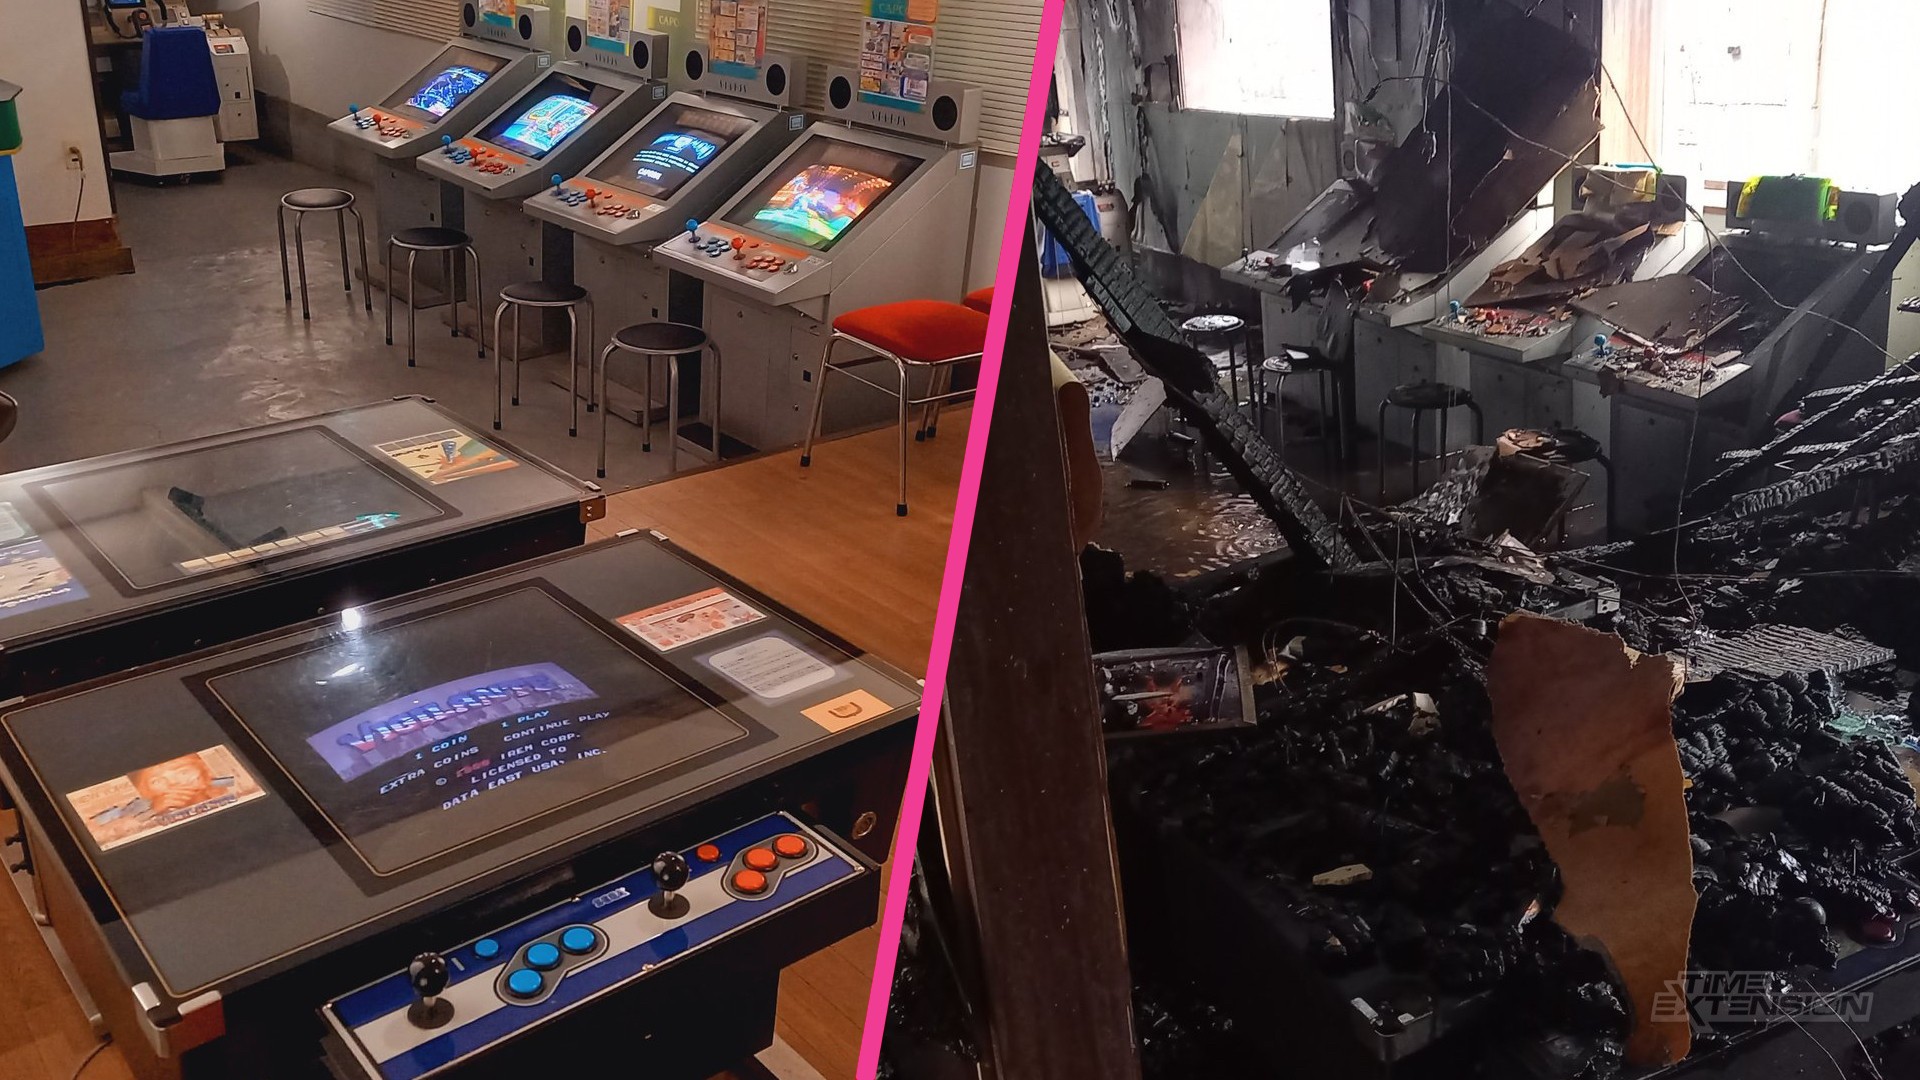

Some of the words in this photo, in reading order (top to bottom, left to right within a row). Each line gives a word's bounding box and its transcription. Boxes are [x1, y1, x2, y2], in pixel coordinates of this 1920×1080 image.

[432, 734, 469, 753] COIN
[517, 710, 550, 723] PLAY
[500, 743, 533, 760] IREM
[540, 733, 582, 747] CORP.
[379, 768, 426, 795] EXTRA
[433, 746, 479, 769] COINS
[503, 719, 572, 742] CONTINUE
[578, 711, 610, 722] PLAY
[471, 753, 542, 784] LICENSED
[549, 746, 567, 756] TO
[442, 788, 480, 811] DATA
[487, 771, 523, 790] EAST
[531, 759, 565, 774] USA,
[577, 748, 608, 760] INC.
[591, 887, 631, 909] SEGA
